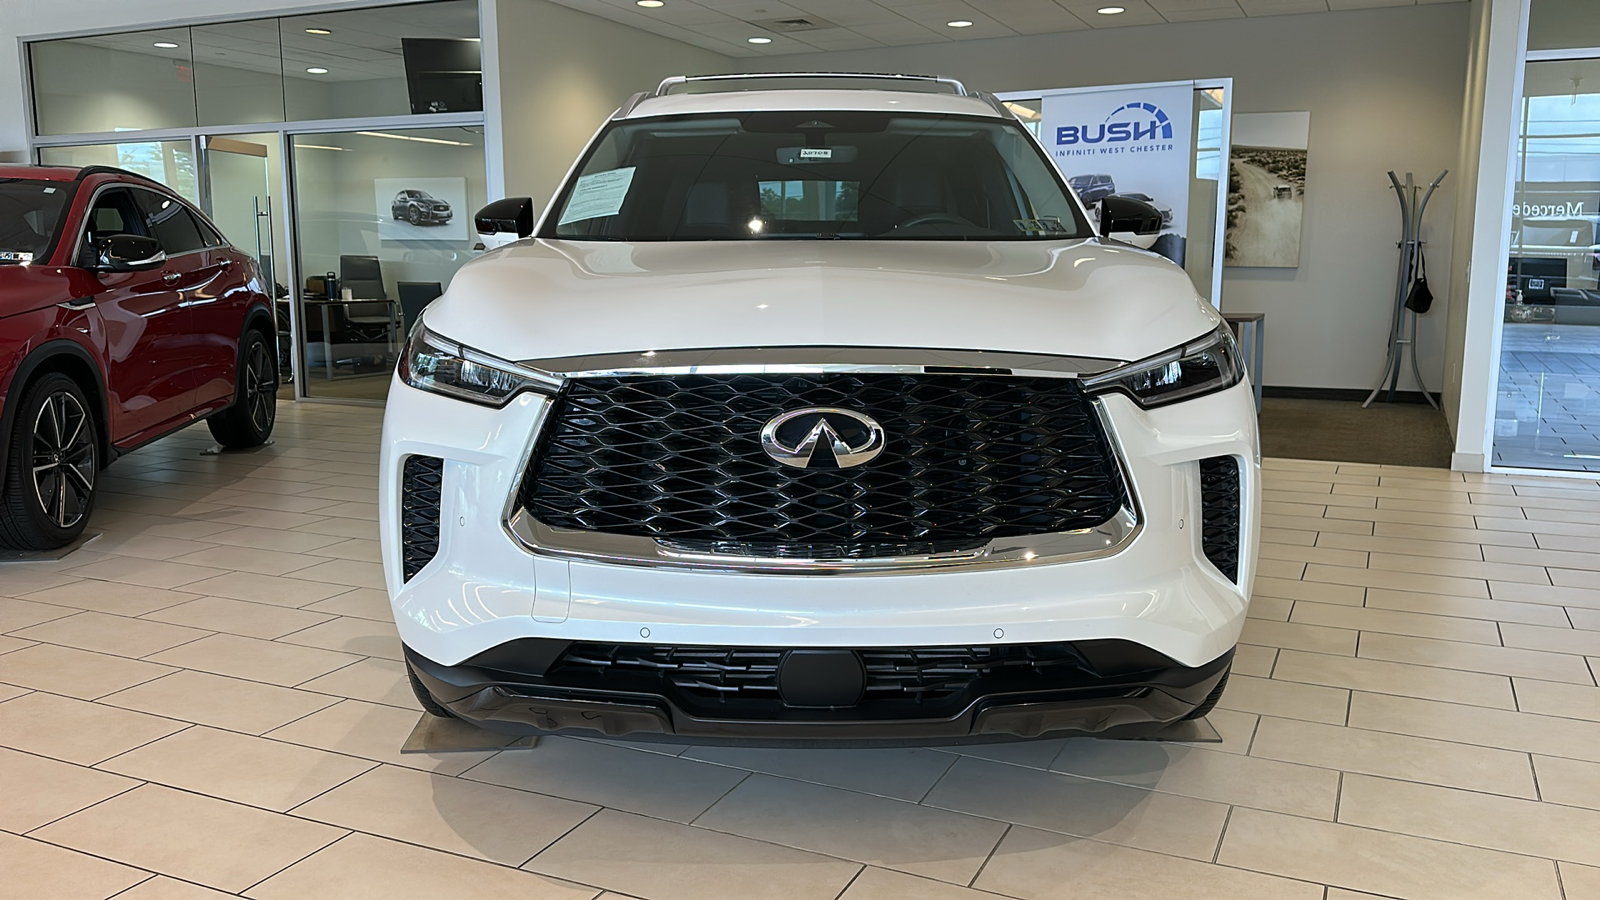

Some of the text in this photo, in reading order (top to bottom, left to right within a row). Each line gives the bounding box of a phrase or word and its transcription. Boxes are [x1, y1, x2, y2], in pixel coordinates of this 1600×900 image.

[1056, 120, 1157, 145] BUSH
[1055, 144, 1173, 157] INFINITI WEST CHESTER
